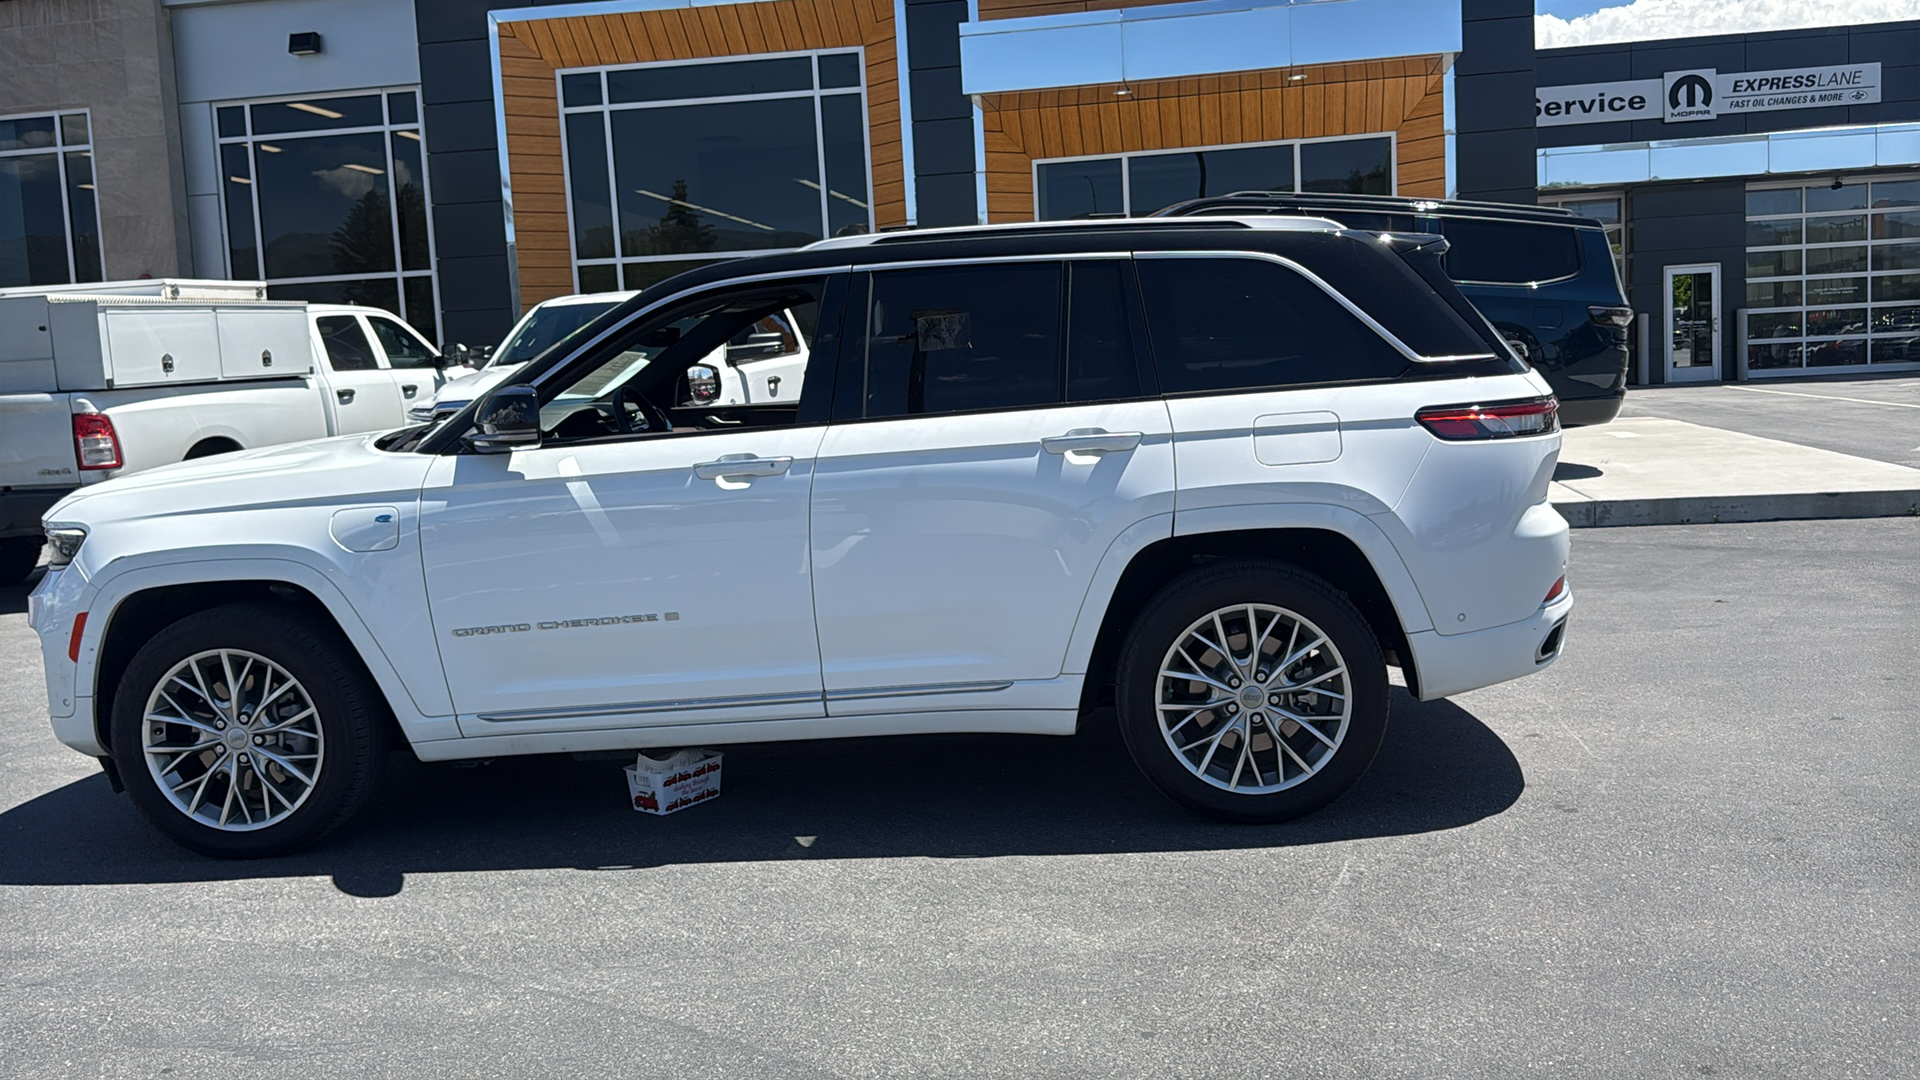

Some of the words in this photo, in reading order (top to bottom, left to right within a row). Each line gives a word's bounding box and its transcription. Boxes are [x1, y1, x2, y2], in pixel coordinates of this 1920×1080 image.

[1729, 99, 1751, 109] FAST
[1752, 98, 1765, 107] OIL
[1767, 95, 1808, 106] CHANGES
[1809, 94, 1816, 103] &
[1818, 93, 1844, 102] MORE
[1670, 109, 1711, 118] MOPAR
[452, 623, 531, 637] GRAND
[537, 613, 659, 630] CHEROKEE
